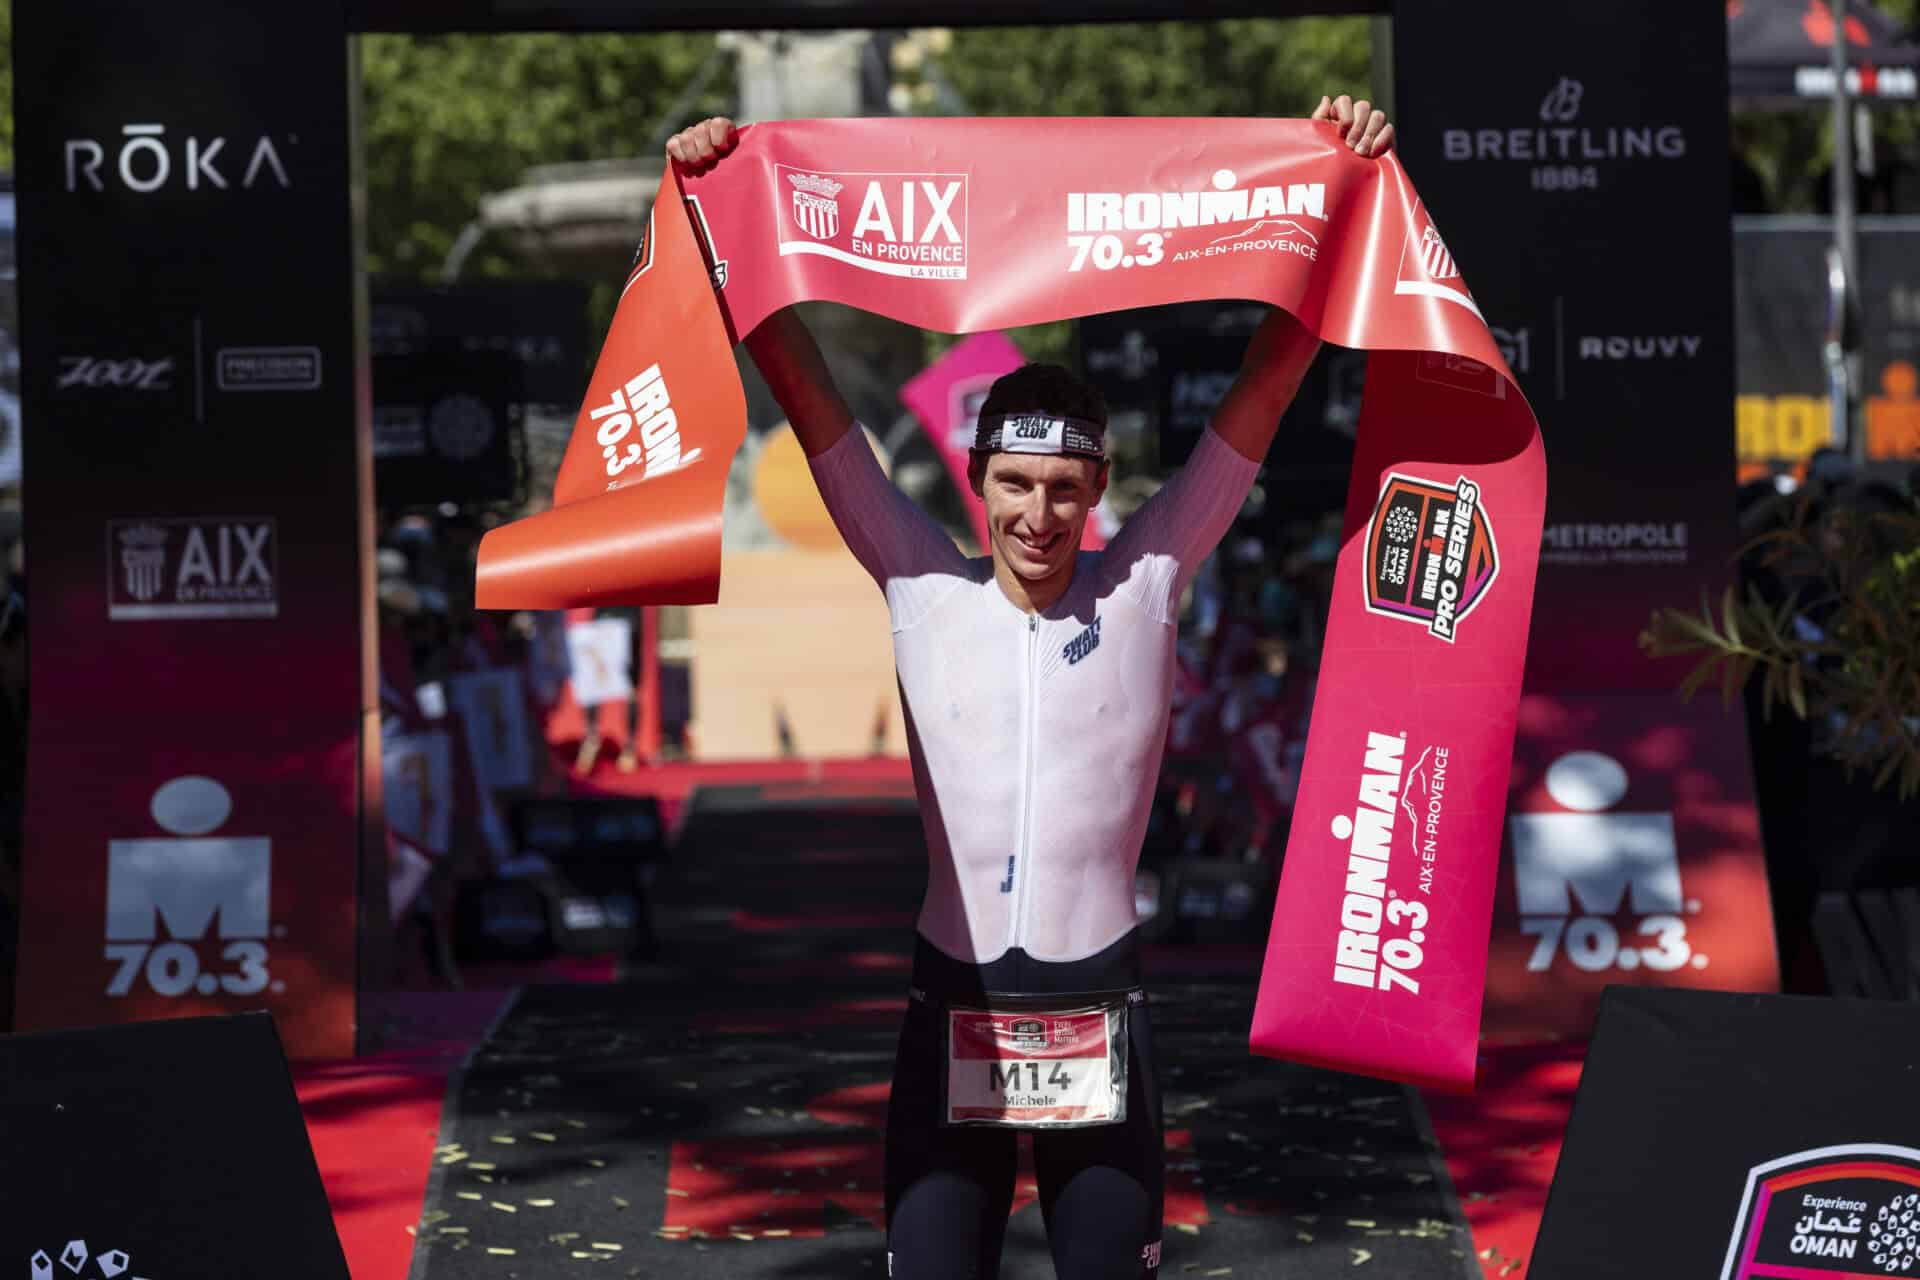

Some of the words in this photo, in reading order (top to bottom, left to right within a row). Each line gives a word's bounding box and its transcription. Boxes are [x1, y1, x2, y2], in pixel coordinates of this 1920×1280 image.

[1443, 127, 1686, 160] BREITLING
[1531, 165, 1598, 190] 1884
[852, 181, 962, 243] AIX
[1067, 169, 1328, 232] IRONMAN
[852, 239, 873, 256] EN
[877, 243, 963, 262] PROVENCE
[1068, 232, 1166, 272] 70.3
[1172, 239, 1318, 263] AIX-EN-PROVENCE
[910, 268, 924, 277] LA
[928, 268, 960, 278] VILLE
[1579, 335, 1701, 359] ROUVY
[1015, 427, 1048, 440] CLUB
[1445, 483, 1476, 577] SERIES
[177, 525, 271, 583] AIX
[1396, 547, 1410, 584] OMAN
[1434, 579, 1457, 637] PRO
[1062, 615, 1101, 659] SWATT
[1068, 632, 1099, 665] CLUB
[1418, 746, 1448, 895] AIX-EN-PROVENCE
[1331, 731, 1407, 989] IRONMAN
[1378, 899, 1429, 995] 70.3
[990, 1062, 1072, 1091] M14
[1003, 1095, 1057, 1107] Michele
[1802, 1194, 1868, 1212] Experience
[1789, 1234, 1858, 1259] OMAN
